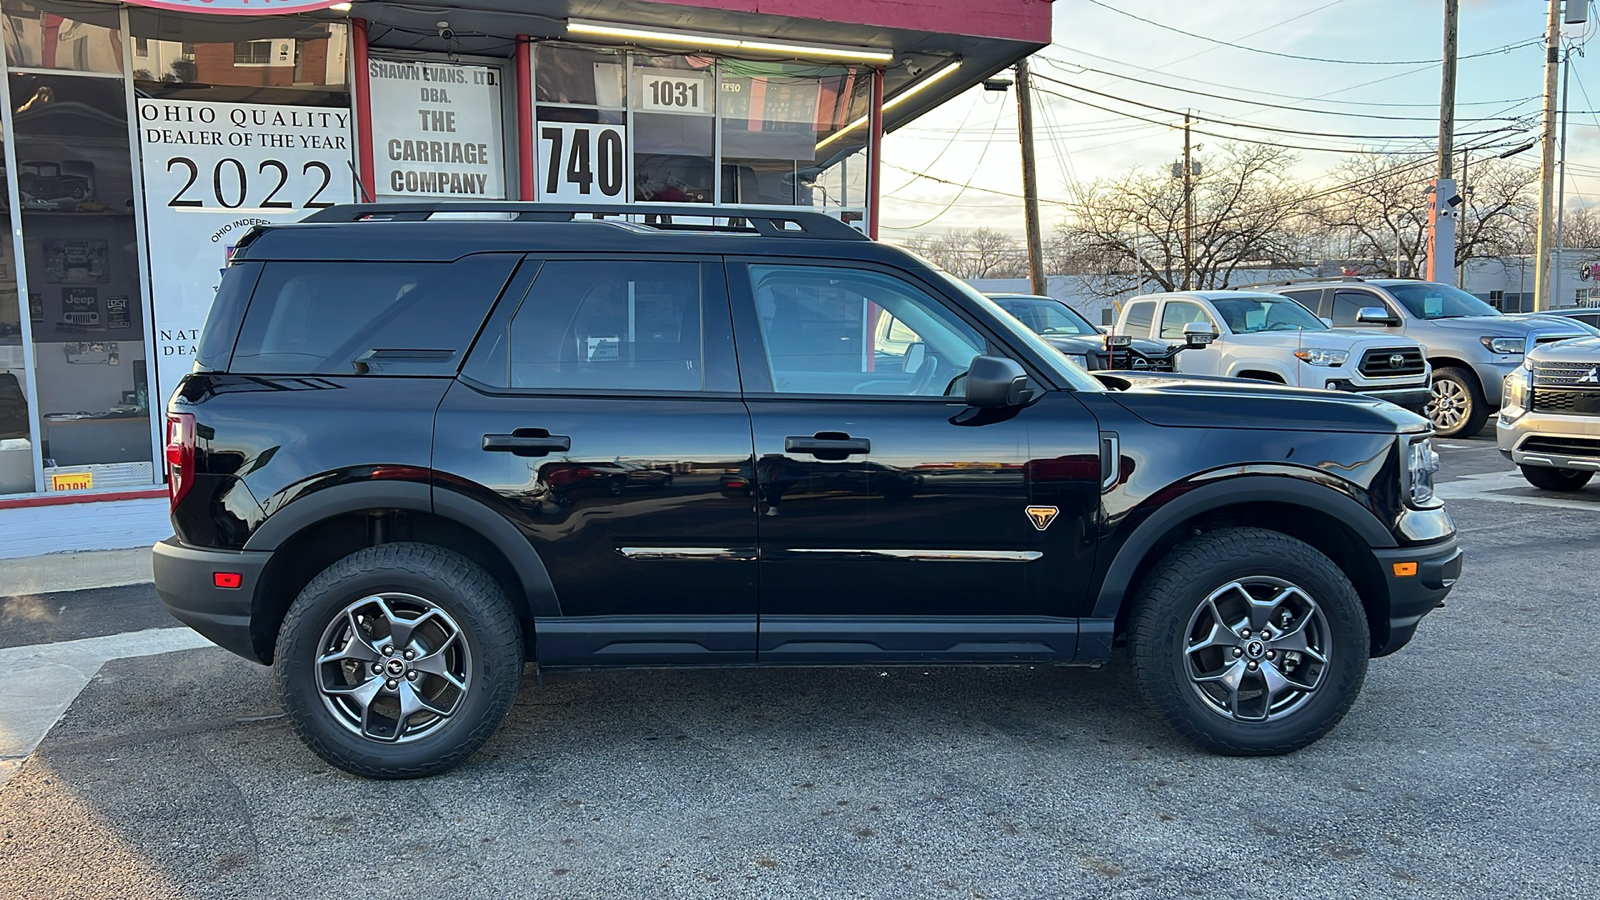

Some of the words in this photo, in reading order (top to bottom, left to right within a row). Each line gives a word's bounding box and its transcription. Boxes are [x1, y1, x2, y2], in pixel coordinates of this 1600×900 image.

[370, 62, 420, 81] SHAWN
[423, 66, 468, 84] EVANS.
[473, 71, 499, 87] LTD.
[420, 87, 452, 104] DBA.
[649, 80, 698, 108] 1031
[141, 104, 216, 124] OHIO
[230, 108, 348, 129] QUALITY
[418, 109, 457, 133] THE
[146, 128, 224, 146] DEALER
[228, 132, 253, 147] OF
[257, 133, 295, 148] THE
[299, 135, 347, 150] YEAR
[387, 138, 488, 165] CARRIAGE
[541, 126, 623, 197] 740
[166, 156, 336, 209] 2022
[390, 169, 488, 195] COMPANY
[211, 224, 232, 243] OHIO
[65, 294, 95, 306] Jeep
